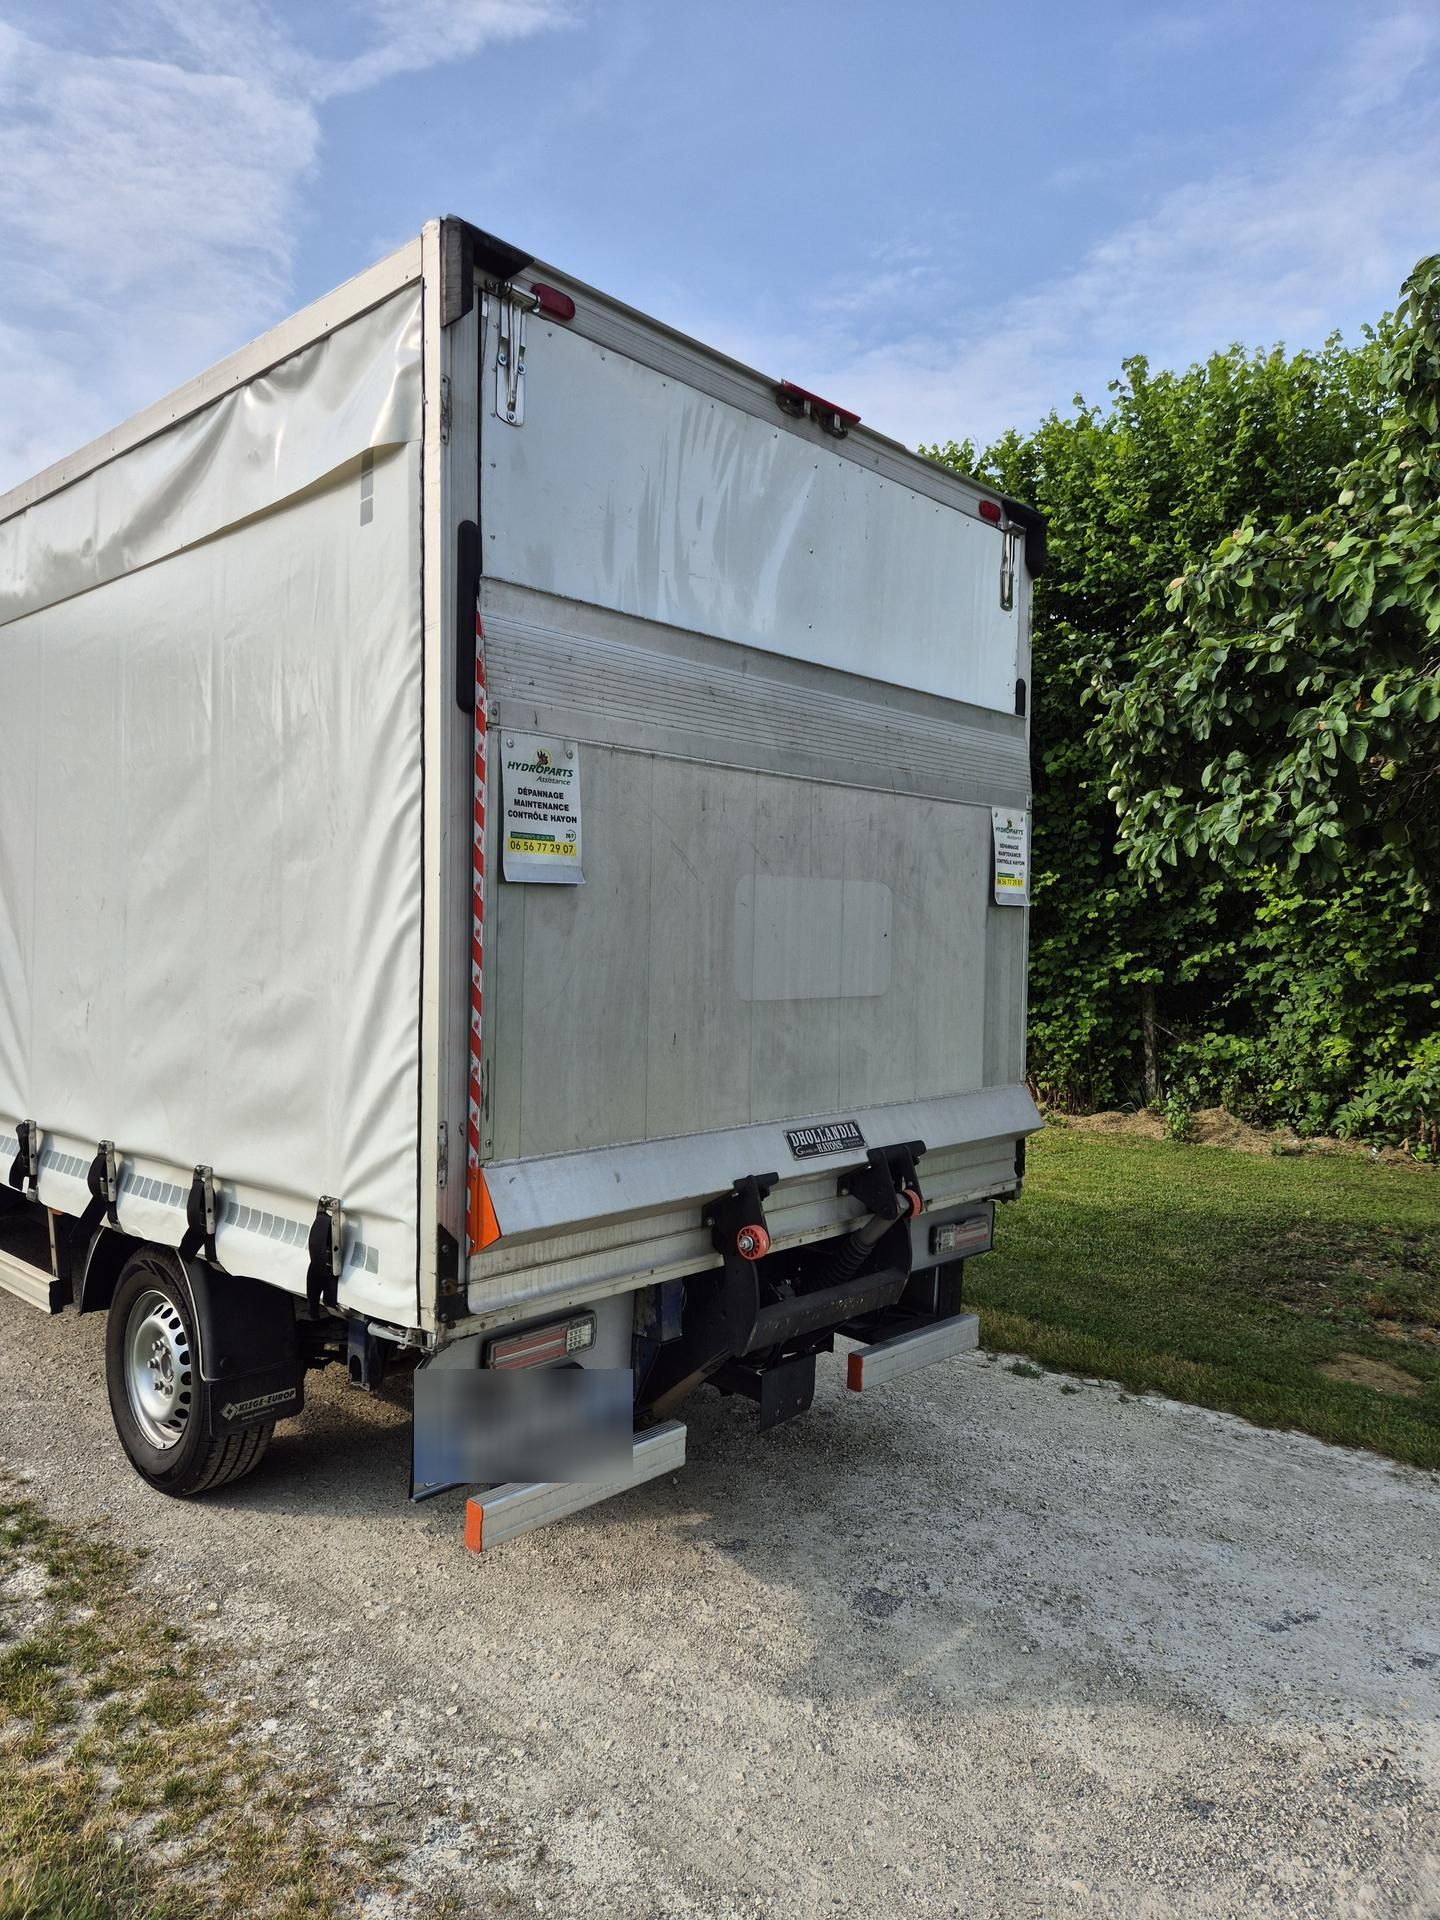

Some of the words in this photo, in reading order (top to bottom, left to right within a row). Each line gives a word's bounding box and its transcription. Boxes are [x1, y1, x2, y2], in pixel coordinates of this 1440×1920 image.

[507, 761, 574, 777] HYDROPARTS
[536, 776, 571, 786] Assistance
[517, 787, 564, 800] DÉPANNAGE
[513, 798, 569, 812] MAINTENANCE
[507, 810, 548, 822] CONTRÔLE
[550, 815, 577, 824] HAYON
[510, 841, 521, 850] 06
[523, 842, 534, 851] 56
[537, 843, 547, 852] 77
[550, 844, 560, 853] 29
[563, 845, 574, 854] 07
[789, 1123, 858, 1147] DHOLLANDIA
[816, 1140, 844, 1153] HAYONS
